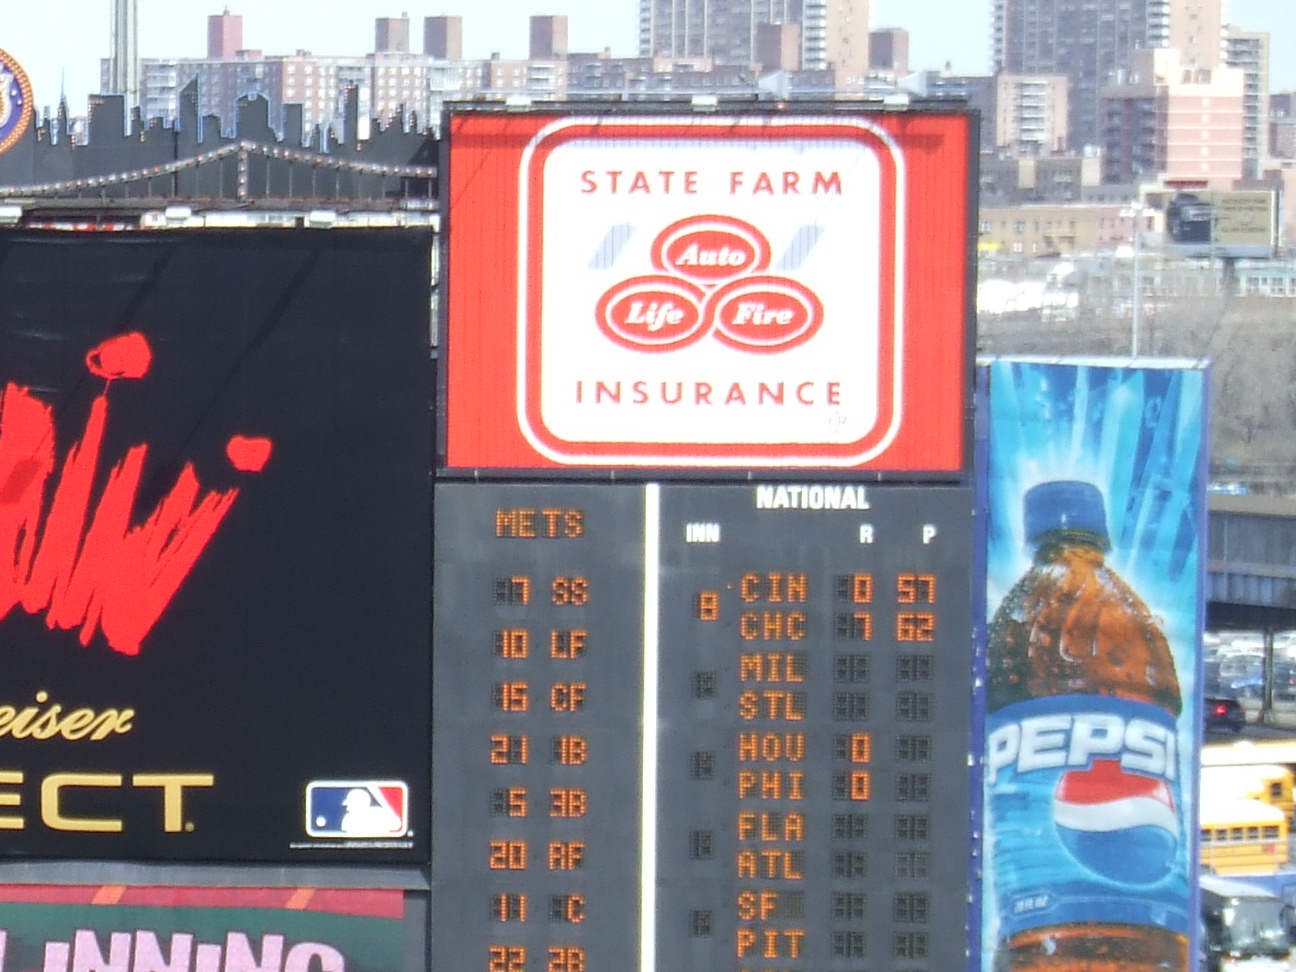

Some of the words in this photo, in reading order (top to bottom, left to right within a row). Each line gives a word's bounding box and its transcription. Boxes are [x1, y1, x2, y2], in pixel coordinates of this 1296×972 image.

[582, 171, 696, 193] STATE
[731, 172, 841, 193] FARM
[675, 243, 747, 266] Auto
[625, 301, 684, 331] Life
[731, 302, 795, 326] Fire
[578, 382, 839, 404] INSURANCE
[757, 486, 869, 509] NATIONAL
[496, 508, 583, 537] METS
[687, 523, 720, 542] INN
[860, 525, 873, 543] R
[923, 526, 935, 543] P
[512, 576, 530, 603] 7
[552, 577, 589, 605] SS
[741, 573, 807, 602] CIN
[852, 573, 873, 603] 0
[897, 573, 936, 603] 57
[741, 612, 804, 640] CHC
[855, 612, 872, 640] 7
[896, 612, 935, 641] 62
[502, 629, 529, 658] 10
[551, 630, 587, 659] LF
[740, 653, 803, 682] MIL
[502, 682, 529, 711] 15
[550, 683, 586, 712] CF
[740, 690, 803, 720] STL
[491, 734, 528, 763] 21
[560, 736, 587, 764] 1B
[739, 733, 804, 761] HOU
[850, 733, 871, 763] 0
[988, 714, 1176, 787] PEPSI
[739, 770, 803, 800] PHI
[850, 770, 871, 800] 0
[508, 787, 527, 816] 5
[551, 788, 586, 817] 3B
[738, 812, 804, 841] FLA
[490, 840, 527, 869] 20
[549, 841, 585, 869] RF
[737, 849, 801, 879] ATL
[500, 894, 527, 920] 11
[567, 894, 584, 923] C
[738, 890, 778, 920] SF
[737, 928, 804, 958] PIT
